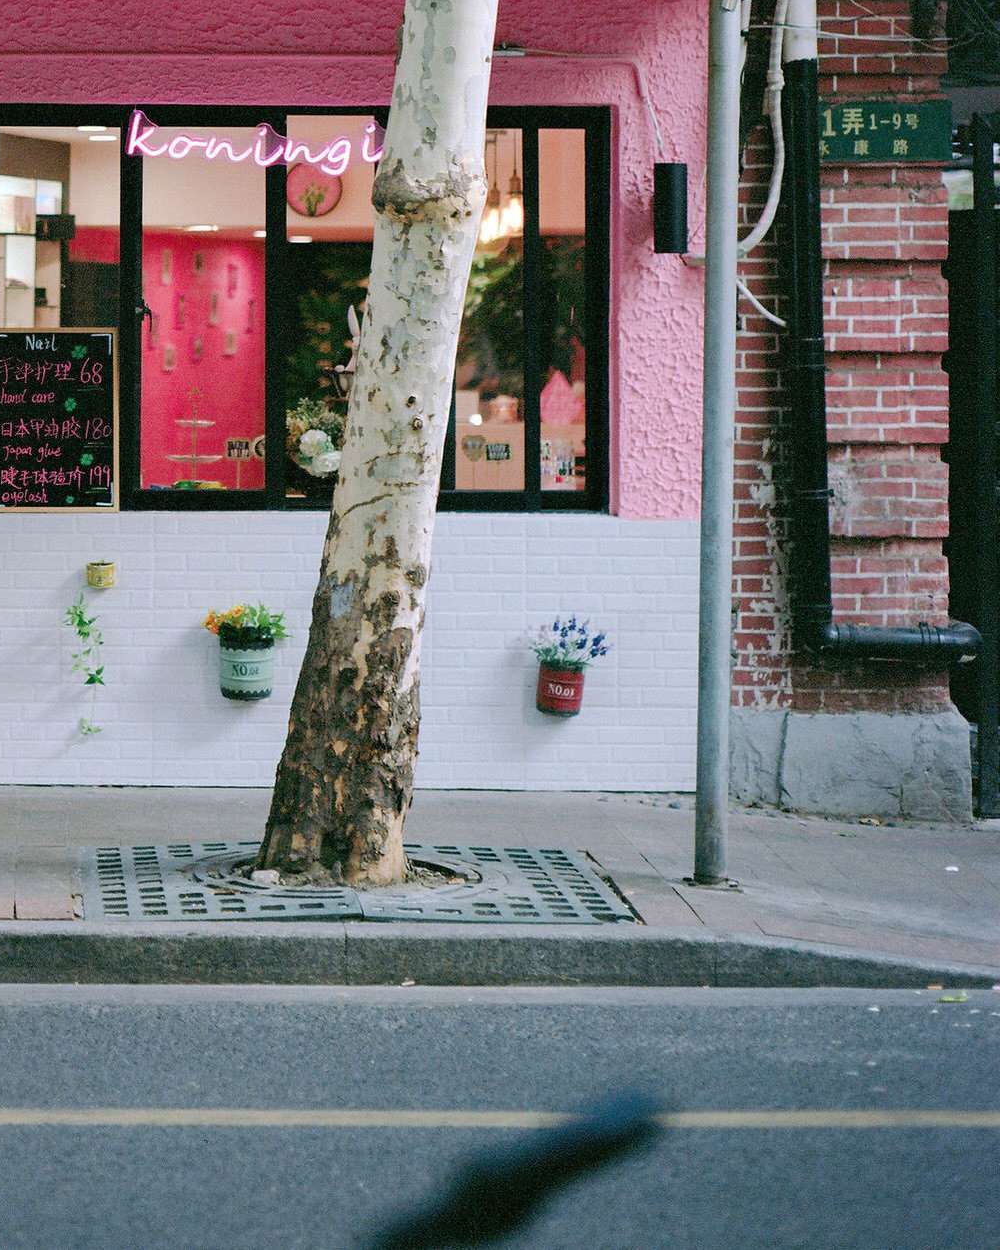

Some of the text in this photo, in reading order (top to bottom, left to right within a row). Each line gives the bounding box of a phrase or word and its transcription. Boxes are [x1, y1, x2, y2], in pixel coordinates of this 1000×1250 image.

[25, 333, 58, 352] Nail
[80, 357, 104, 385] 68
[0, 388, 56, 405] hand care
[84, 417, 112, 440] 180
[37, 443, 62, 463] glue
[0, 465, 110, 490] 睫毛体验价 199
[1, 489, 49, 508] eyelash
